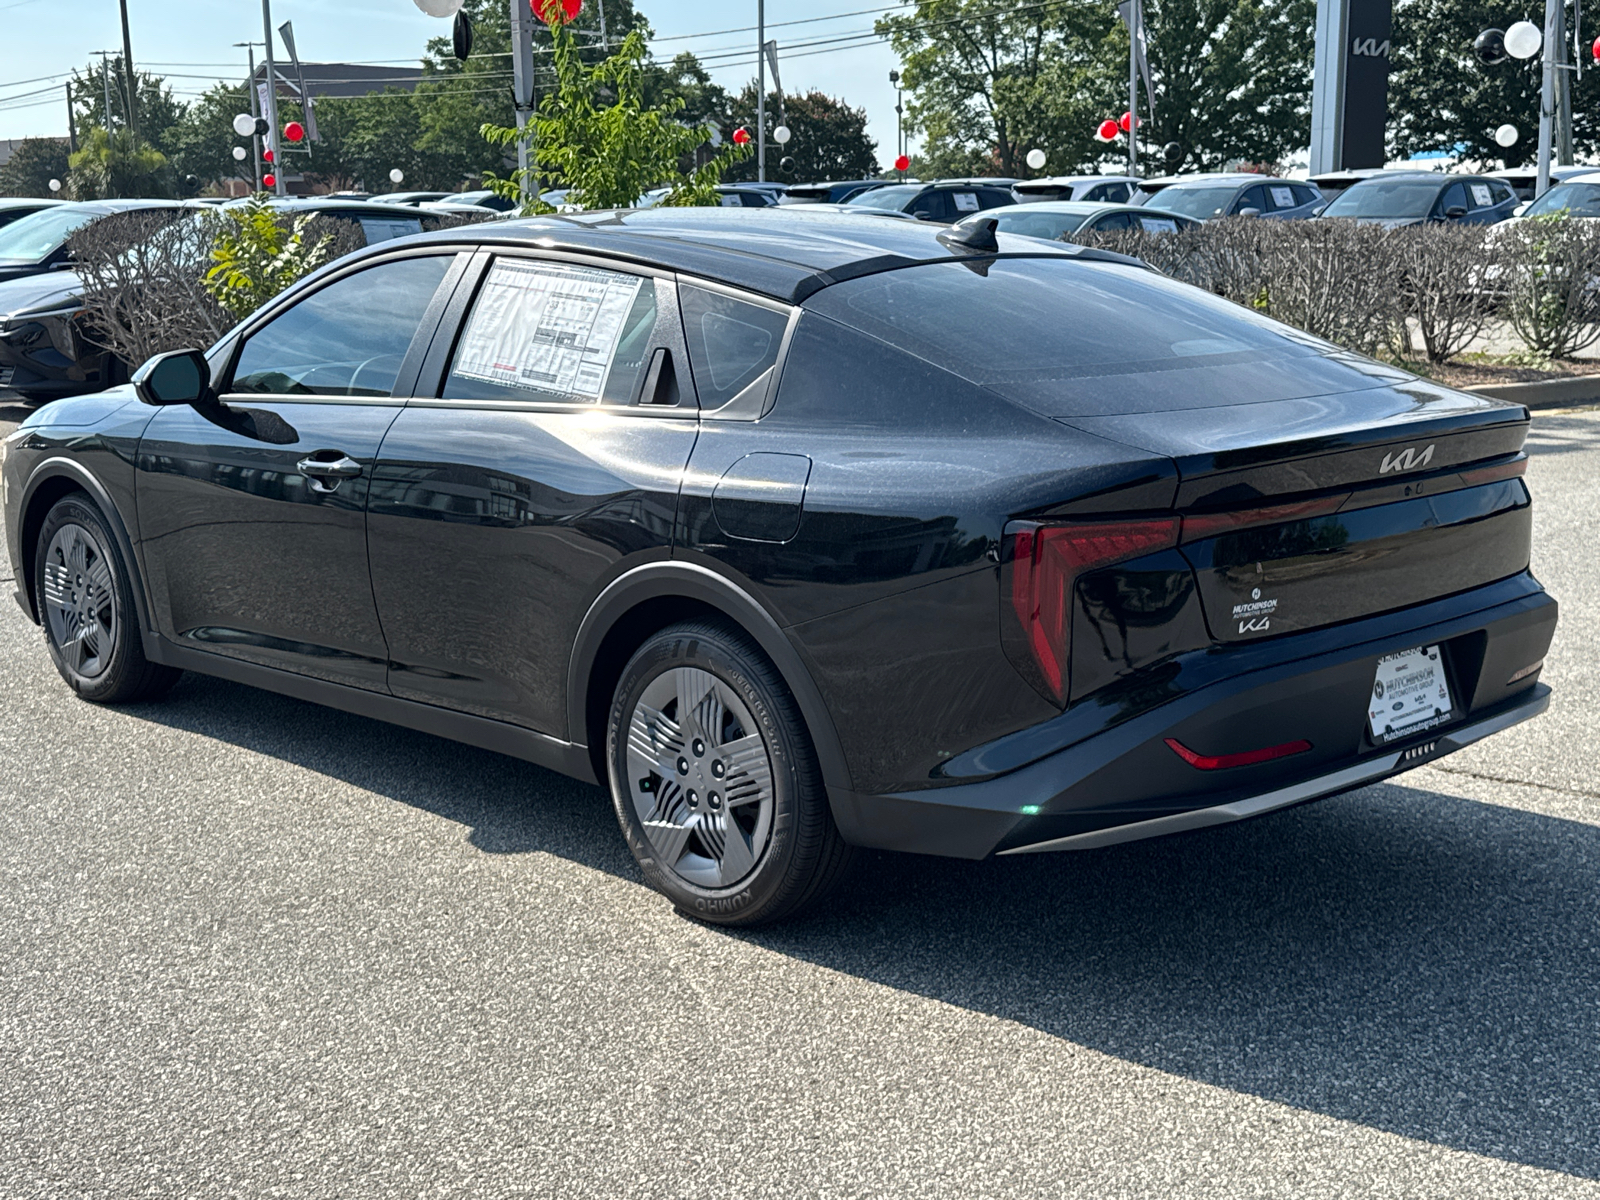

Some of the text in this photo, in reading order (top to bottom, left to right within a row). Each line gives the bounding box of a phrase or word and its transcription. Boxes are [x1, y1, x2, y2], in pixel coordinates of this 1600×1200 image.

[1352, 37, 1390, 57] KIA
[1379, 444, 1435, 474] KIA
[1232, 599, 1278, 614] HUTCHINSON
[1239, 616, 1270, 634] K4
[1386, 666, 1435, 693] HUTCHINSON
[1388, 679, 1435, 700] AUTOMOTIVE GROUP
[611, 688, 628, 766] SOLUS
[695, 888, 754, 913] KUMHO
